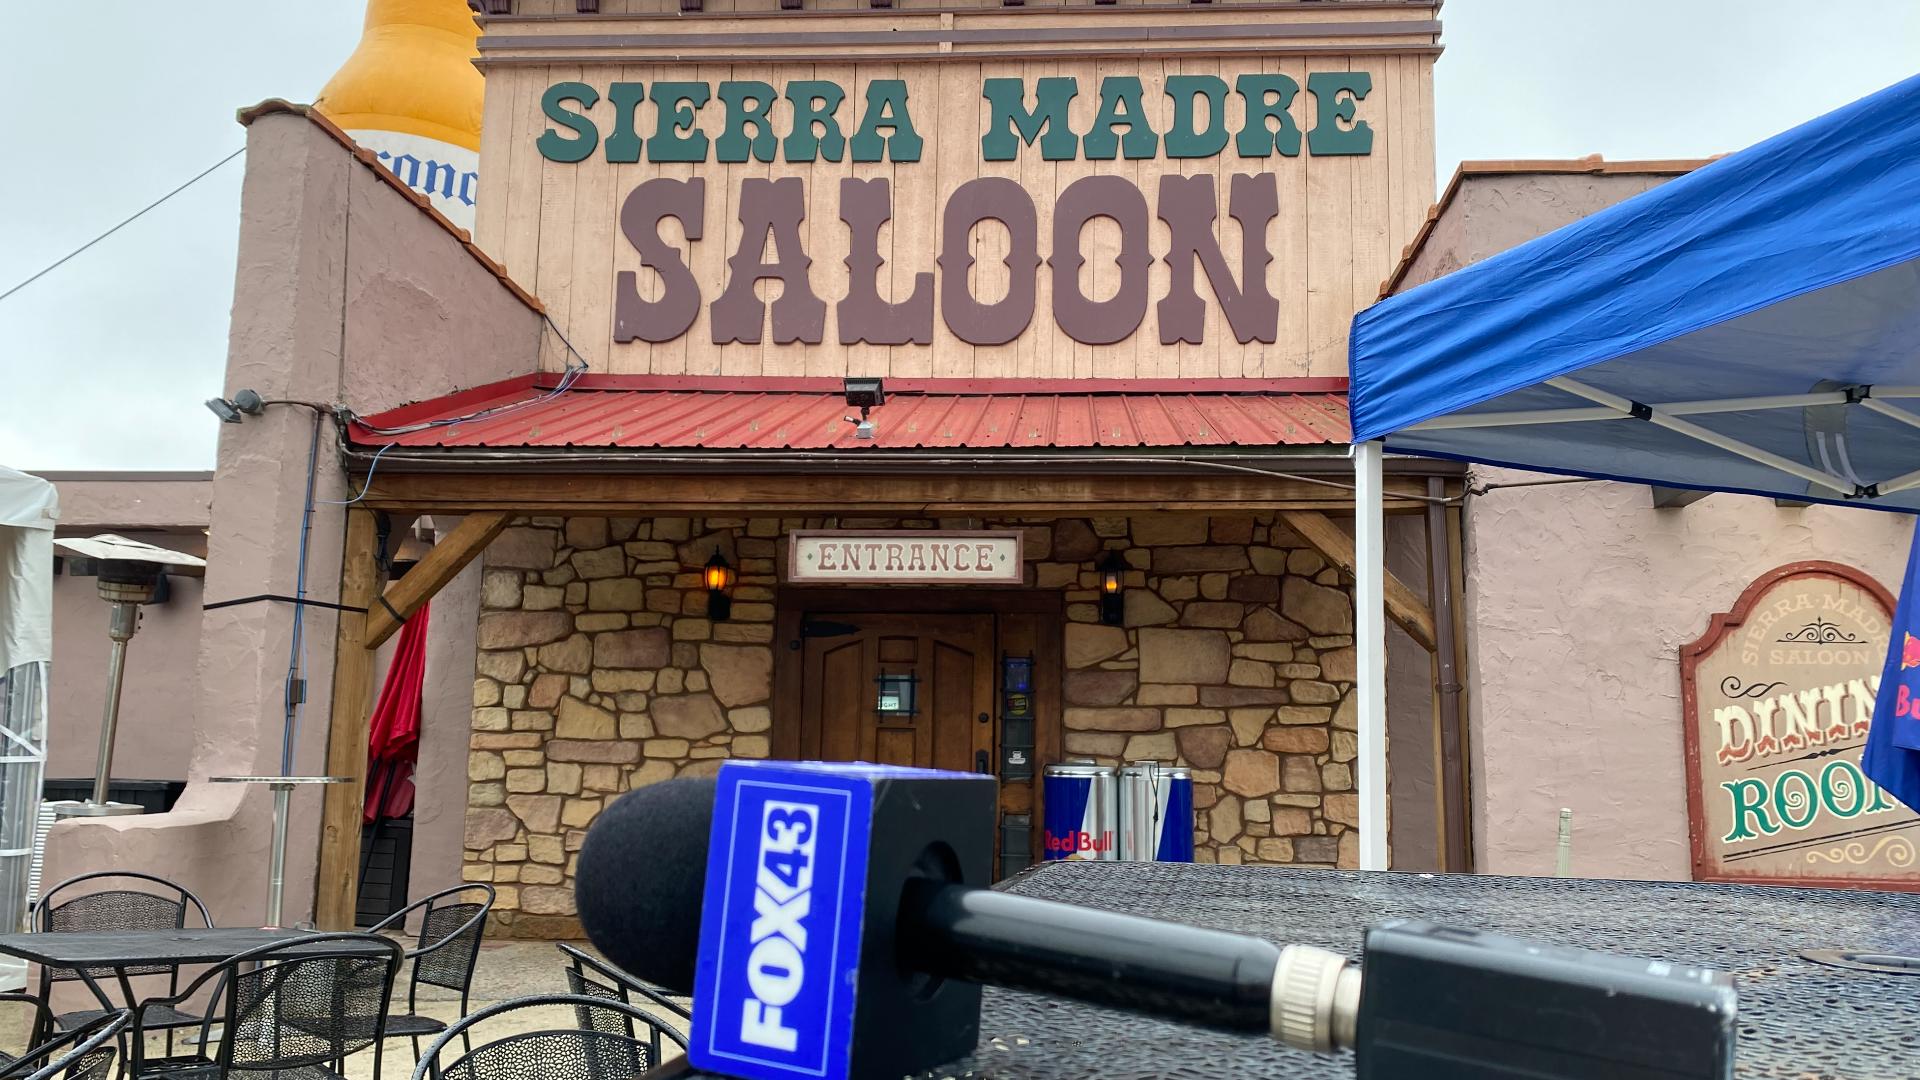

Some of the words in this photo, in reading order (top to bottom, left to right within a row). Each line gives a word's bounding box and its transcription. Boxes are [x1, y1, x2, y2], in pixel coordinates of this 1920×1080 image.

[536, 80, 923, 163] SIERRA
[982, 72, 1374, 161] MADRE
[613, 173, 1279, 346] SALOON
[818, 543, 994, 571] ENTRANCE
[1742, 593, 1815, 666] SIERRA
[1769, 649, 1870, 665] SALOON
[1077, 831, 1112, 851] Bull
